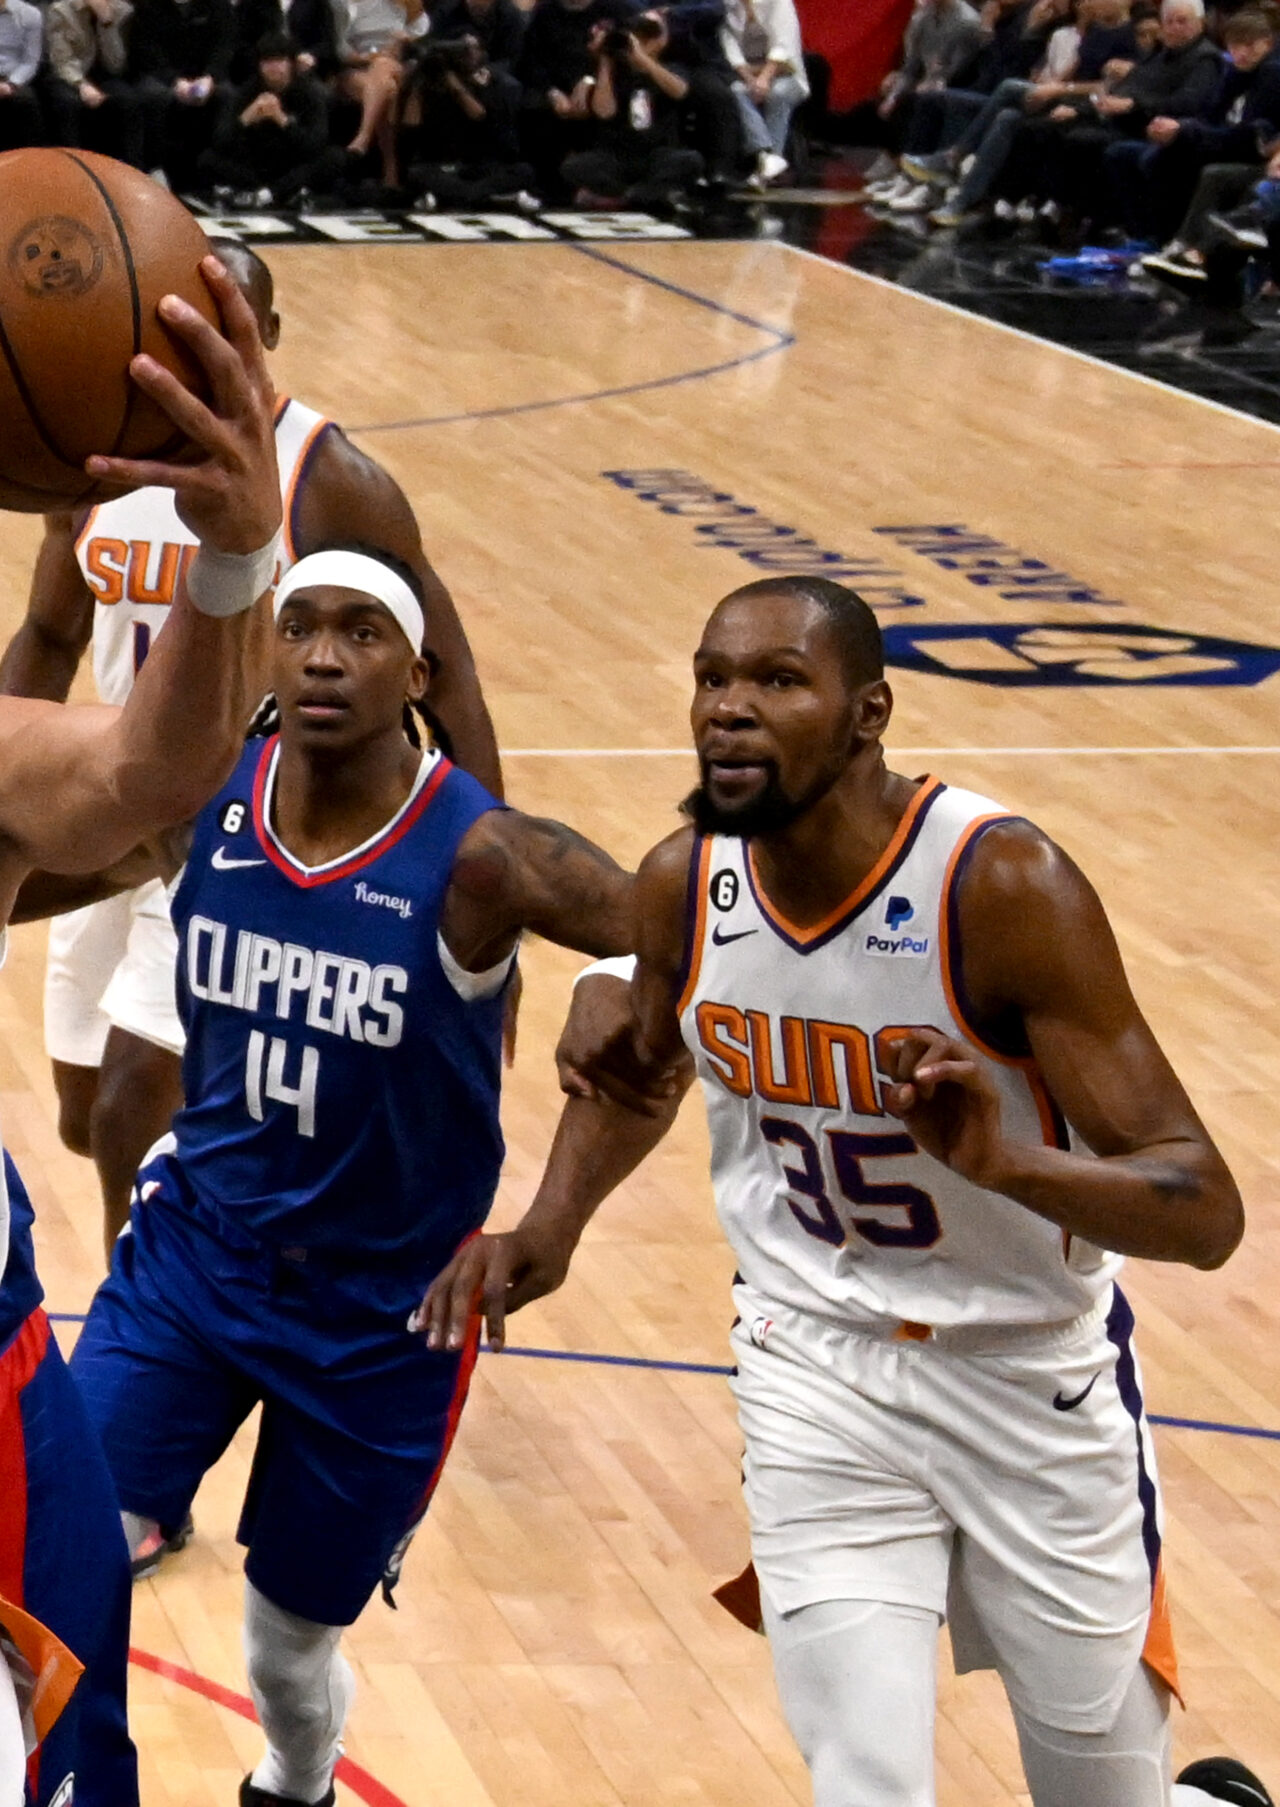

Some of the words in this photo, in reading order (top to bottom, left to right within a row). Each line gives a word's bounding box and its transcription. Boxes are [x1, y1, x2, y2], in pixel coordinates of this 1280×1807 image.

[87, 536, 200, 605] SU
[222, 803, 246, 834] 6
[353, 881, 413, 918] honey
[865, 935, 929, 955] PayPal
[186, 913, 409, 1048] CLIPPERS
[244, 1028, 320, 1138] 14
[759, 1115, 943, 1250] 35
